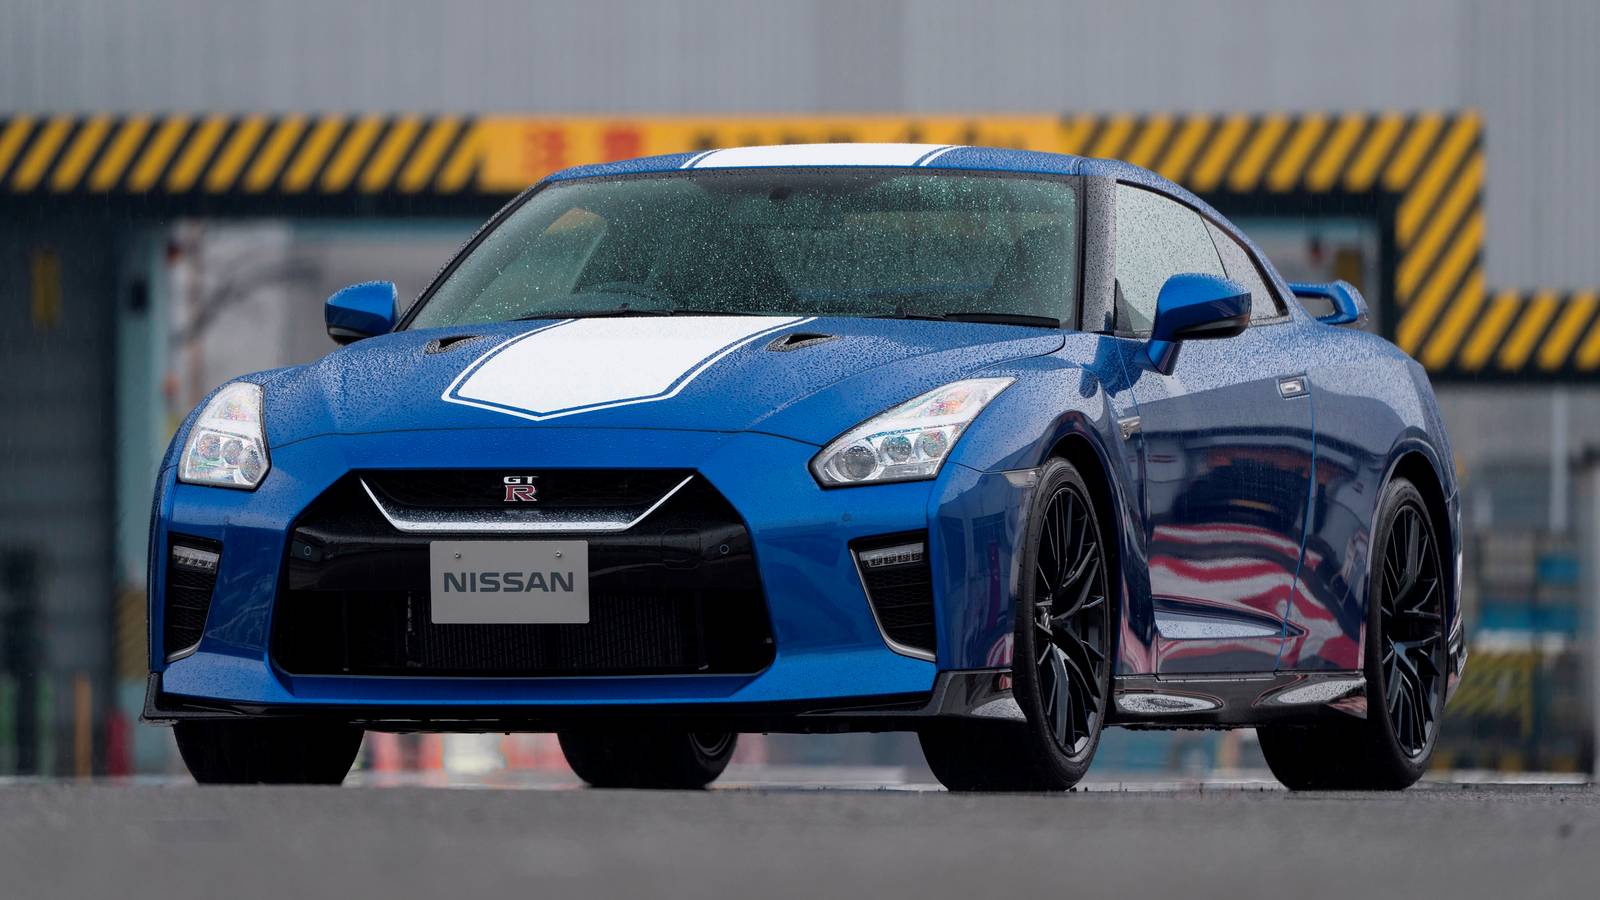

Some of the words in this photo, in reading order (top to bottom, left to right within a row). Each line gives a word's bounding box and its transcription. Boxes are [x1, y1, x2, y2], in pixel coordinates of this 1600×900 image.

[503, 475, 539, 484] GT
[503, 484, 538, 502] R
[443, 571, 574, 593] NISSAN
